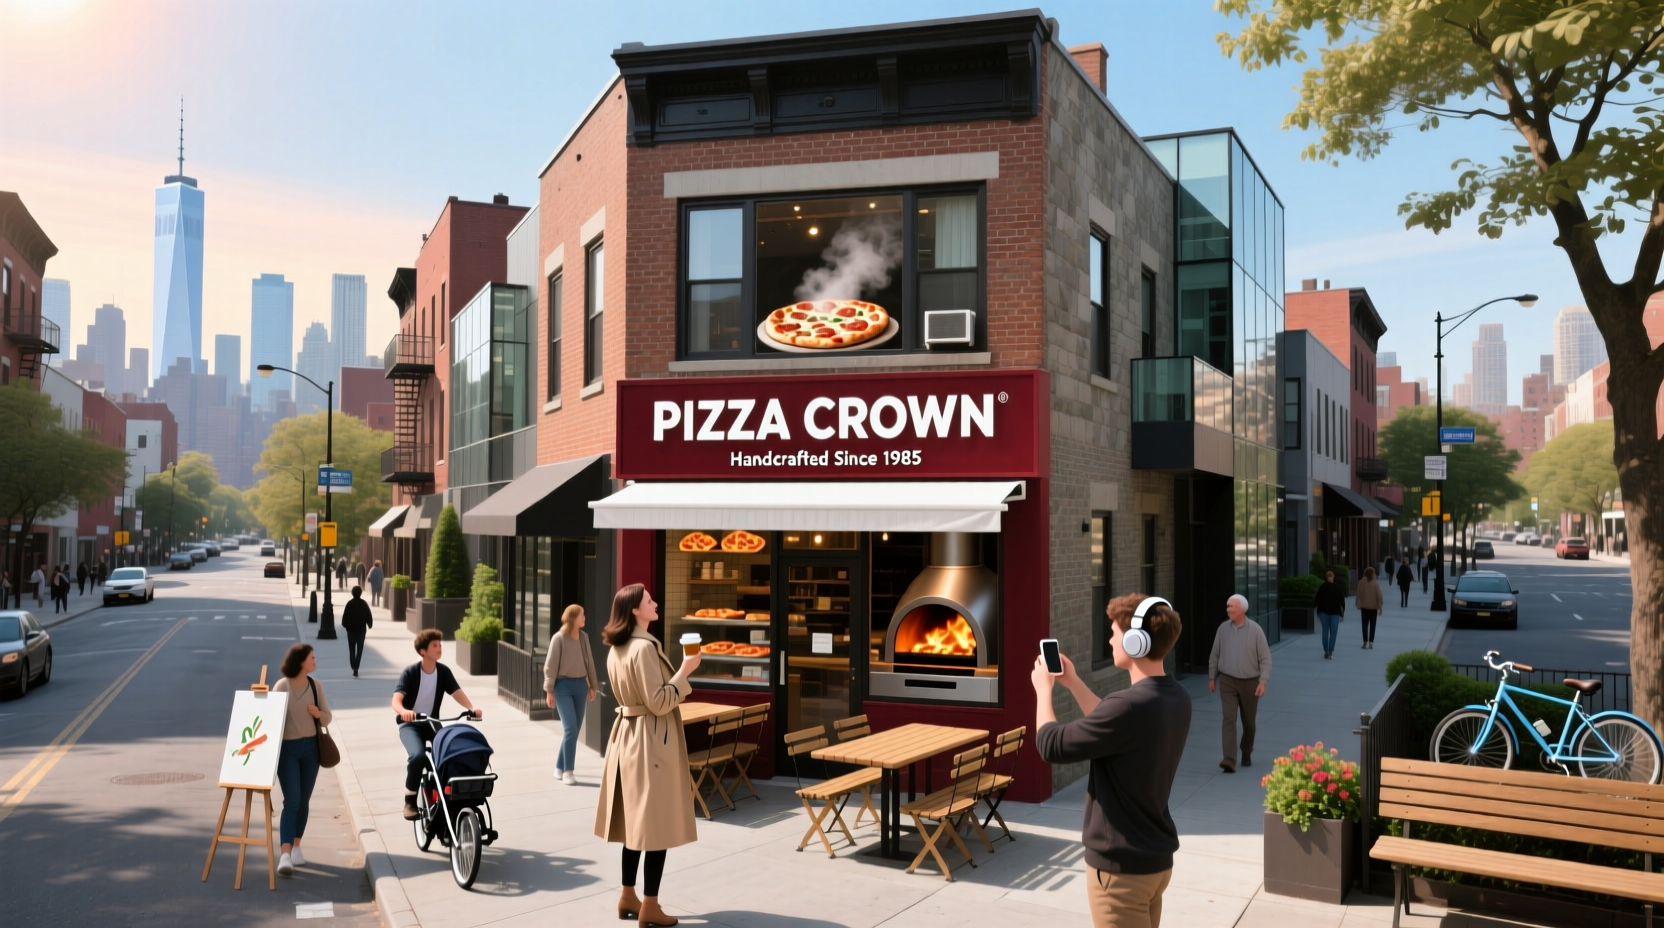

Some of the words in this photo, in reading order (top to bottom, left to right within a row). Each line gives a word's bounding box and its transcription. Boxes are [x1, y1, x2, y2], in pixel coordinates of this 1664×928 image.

[653, 397, 792, 442] PIZZA
[730, 449, 829, 467] Handcrafted
[833, 450, 878, 467] Since
[882, 449, 922, 466] 1985
